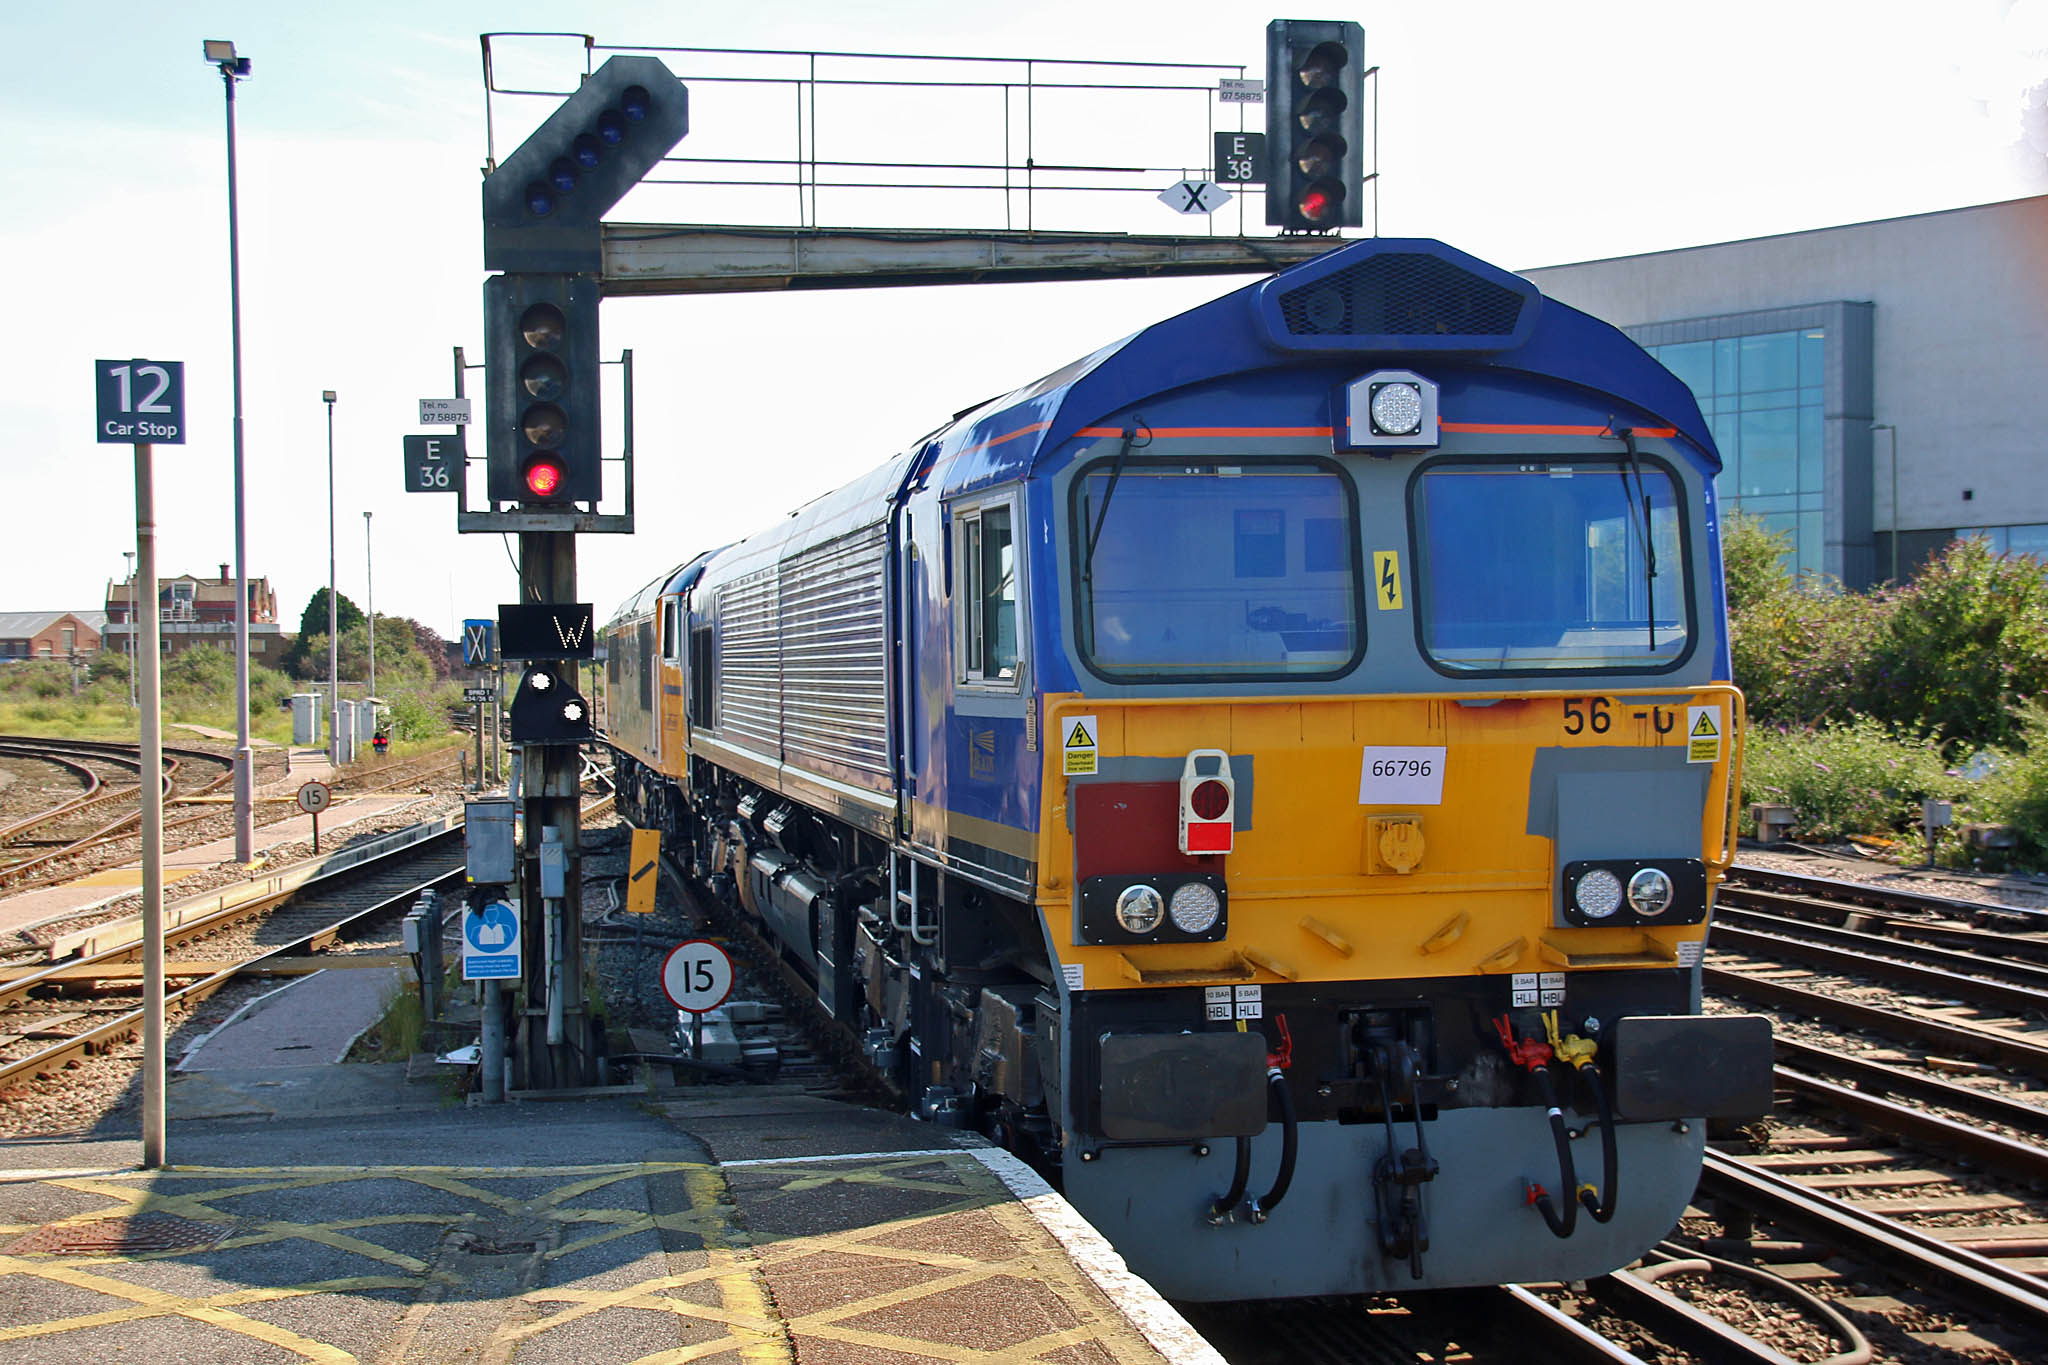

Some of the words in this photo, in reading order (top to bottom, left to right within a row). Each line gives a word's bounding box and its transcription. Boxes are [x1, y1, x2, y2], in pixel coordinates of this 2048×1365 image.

[1233, 137, 1245, 155] E
[1227, 161, 1252, 179] 38
[1183, 183, 1207, 212] X
[110, 365, 171, 413] 12
[423, 413, 435, 422] 07
[437, 413, 469, 422] 58875
[105, 421, 134, 435] Car
[138, 421, 177, 439] Stop
[427, 440, 440, 460] E
[421, 466, 449, 487] 36
[553, 615, 588, 649] W
[1563, 696, 1611, 735] 56
[1372, 760, 1432, 777] 66796
[305, 790, 321, 805] 15
[684, 959, 714, 993] 15
[1515, 993, 1536, 1005] HLL
[1208, 1006, 1229, 1018] HBL
[1239, 1005, 1259, 1016] HLL
